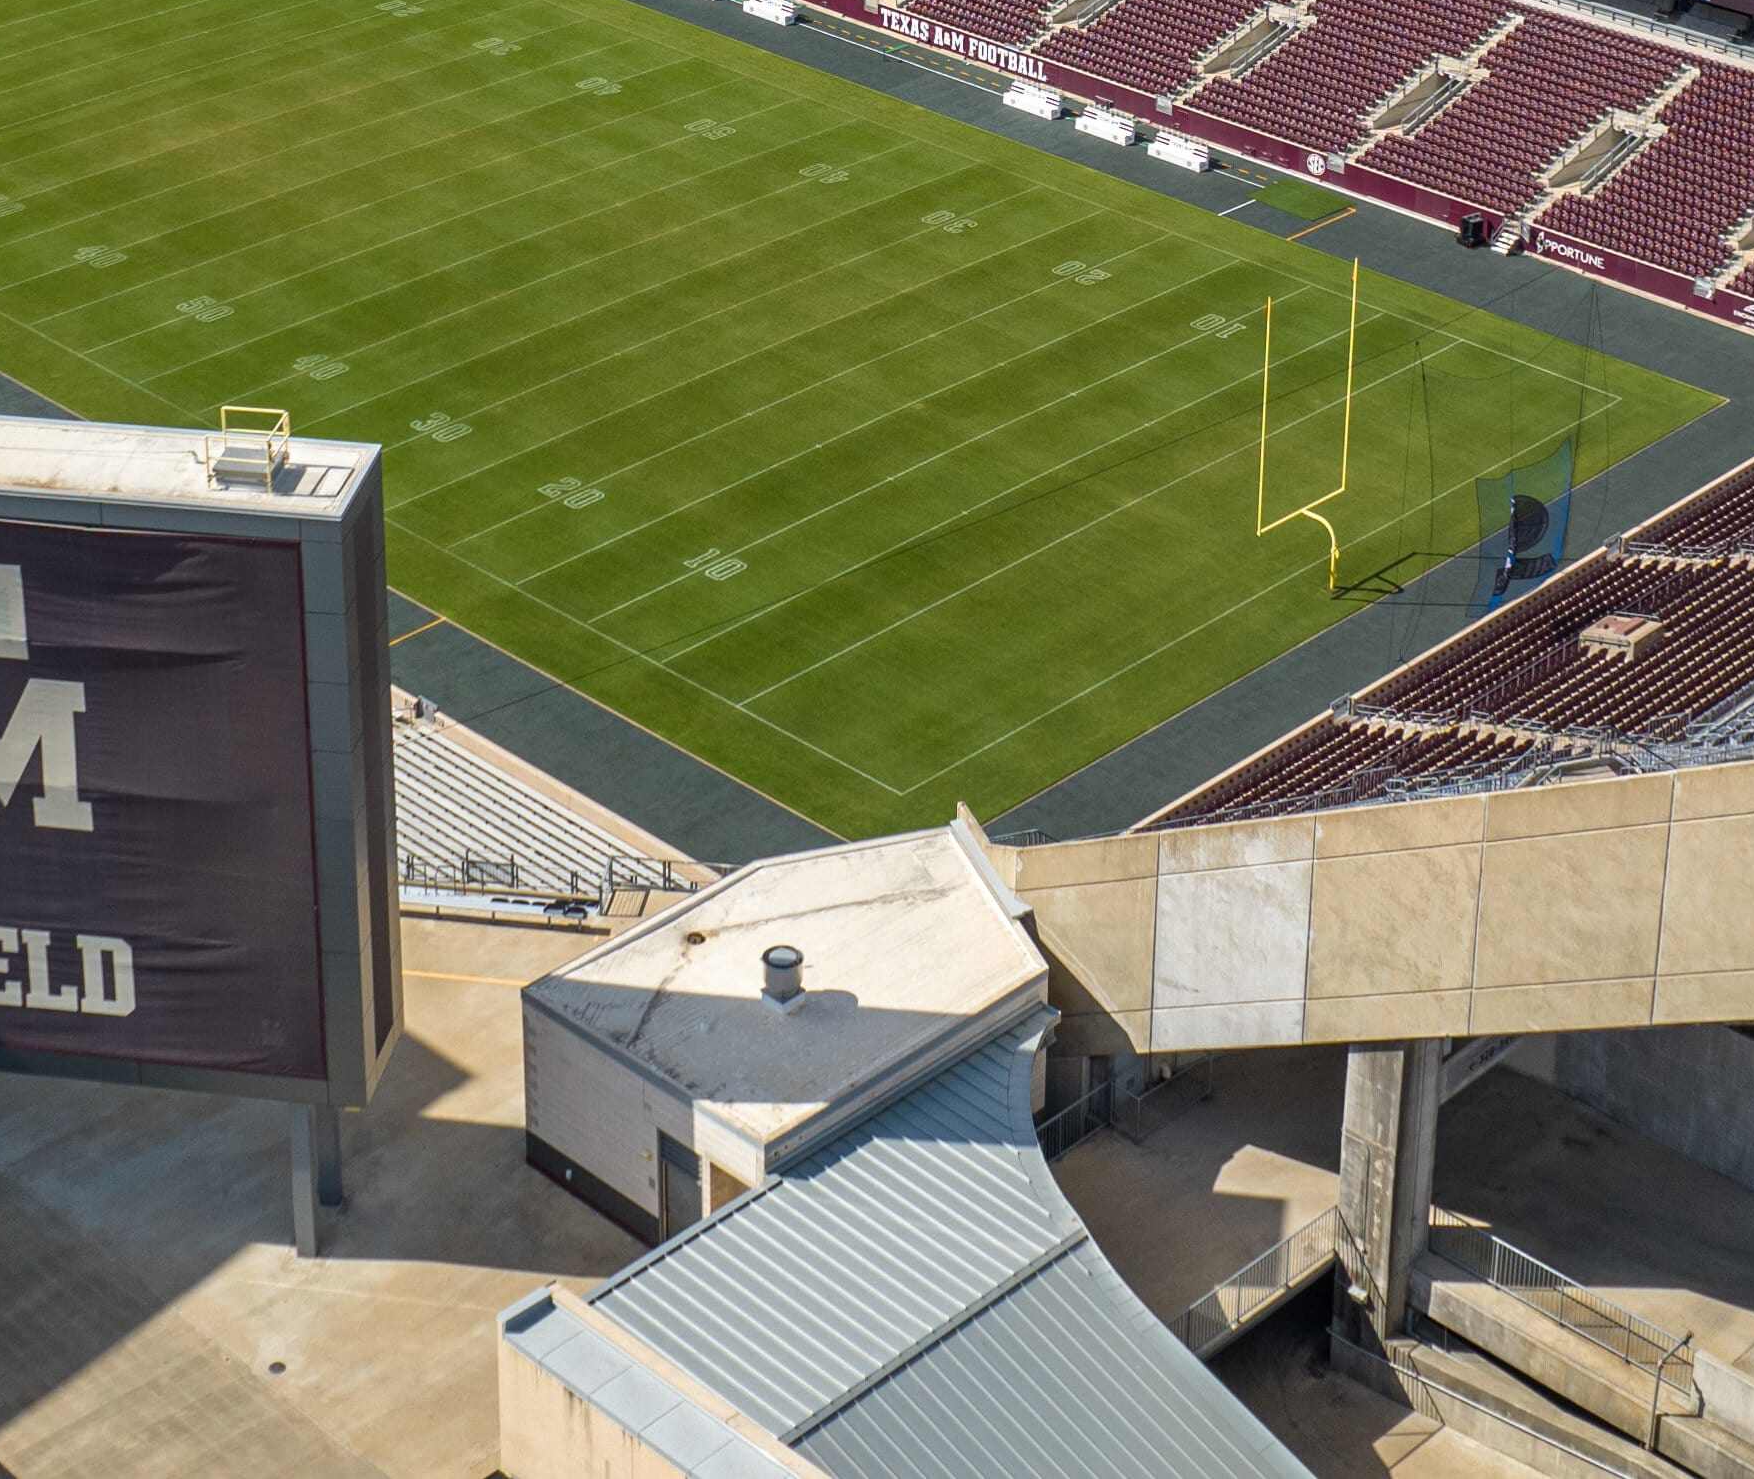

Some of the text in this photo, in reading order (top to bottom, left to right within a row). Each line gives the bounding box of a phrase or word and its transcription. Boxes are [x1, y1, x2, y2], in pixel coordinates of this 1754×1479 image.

[880, 7, 1047, 83] TEXAS A&M FOOTBALL
[921, 210, 978, 234] 30
[1052, 260, 1112, 286] 20
[176, 296, 235, 322] 50
[1190, 313, 1247, 339] 10
[293, 354, 350, 380] 40
[410, 411, 472, 443] 30
[537, 477, 606, 509] 20
[683, 548, 748, 581] 10
